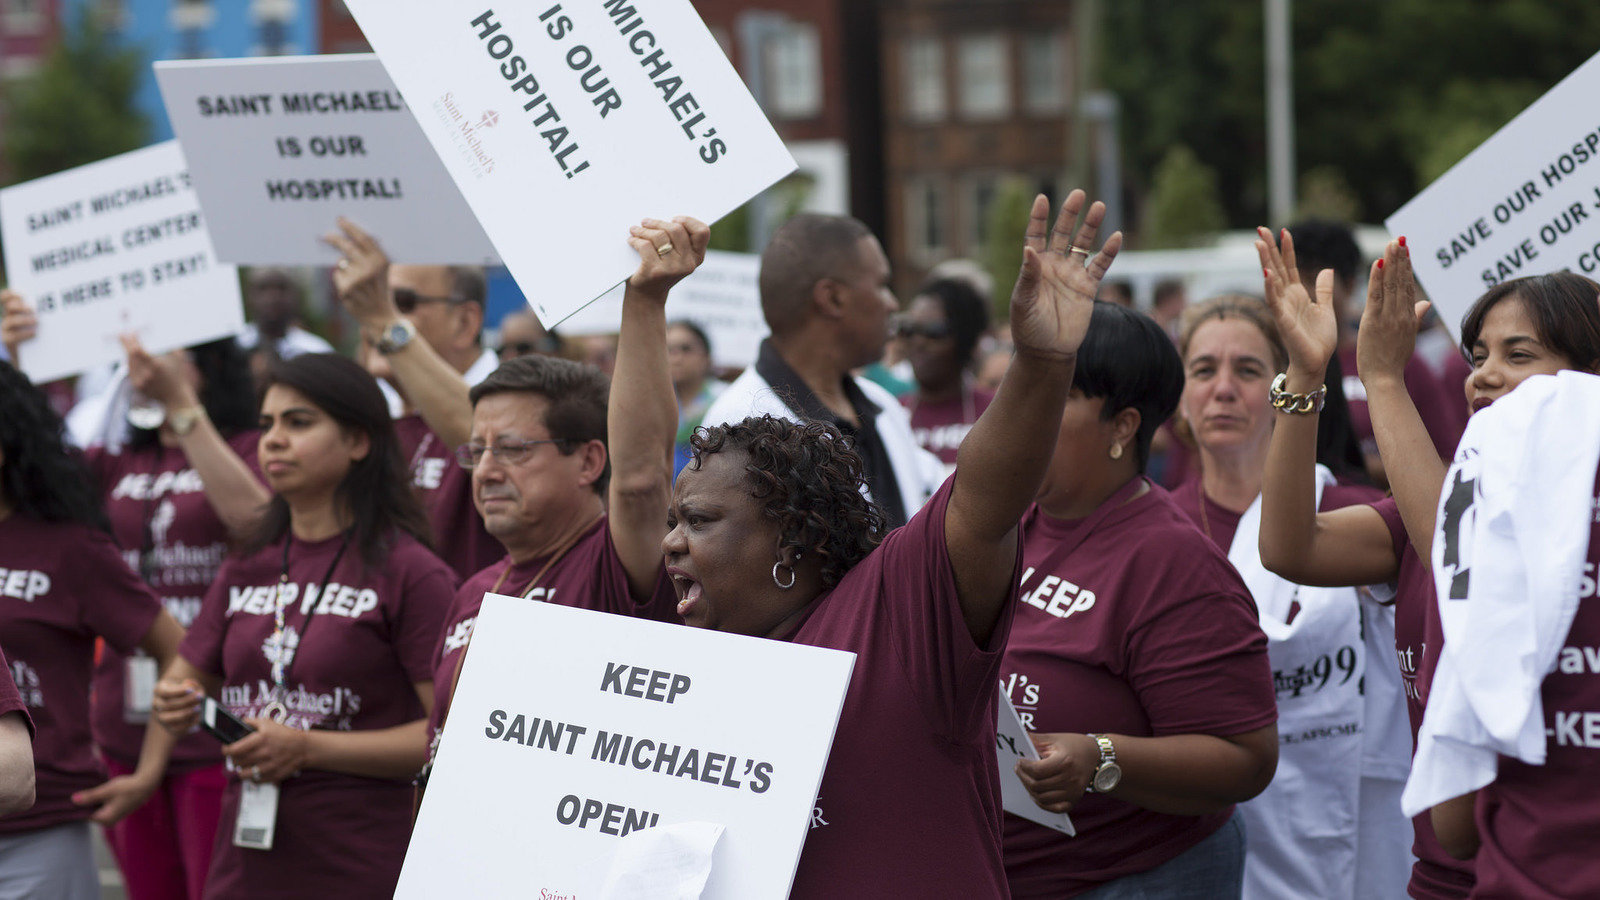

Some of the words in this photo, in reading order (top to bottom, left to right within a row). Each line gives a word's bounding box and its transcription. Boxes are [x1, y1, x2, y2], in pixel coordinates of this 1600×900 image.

[538, 4, 573, 40] IS
[566, 45, 622, 119] OUR
[603, 0, 727, 164] MICHAEL'S
[198, 94, 272, 117] SAINT
[281, 90, 404, 113] MICHAEL'
[470, 9, 590, 179] HOSPITAL!
[276, 136, 303, 158] IS
[309, 135, 367, 157] OUR
[267, 178, 403, 201] HOSPITAL!
[1436, 217, 1493, 268] SAVE
[1493, 180, 1542, 224] OUR
[1541, 125, 1600, 188] HOSP
[27, 201, 83, 233] SAINT
[31, 237, 116, 273] MEDICAL
[122, 212, 201, 249] CENTER
[1482, 238, 1539, 287] SAVE
[1540, 202, 1590, 245] OUR
[61, 277, 114, 307] HERE
[120, 269, 146, 292] TO
[0, 568, 51, 602] EEP
[600, 662, 691, 704] KEEP
[485, 709, 587, 755] SAINT
[591, 730, 774, 794] MICHAEL'S
